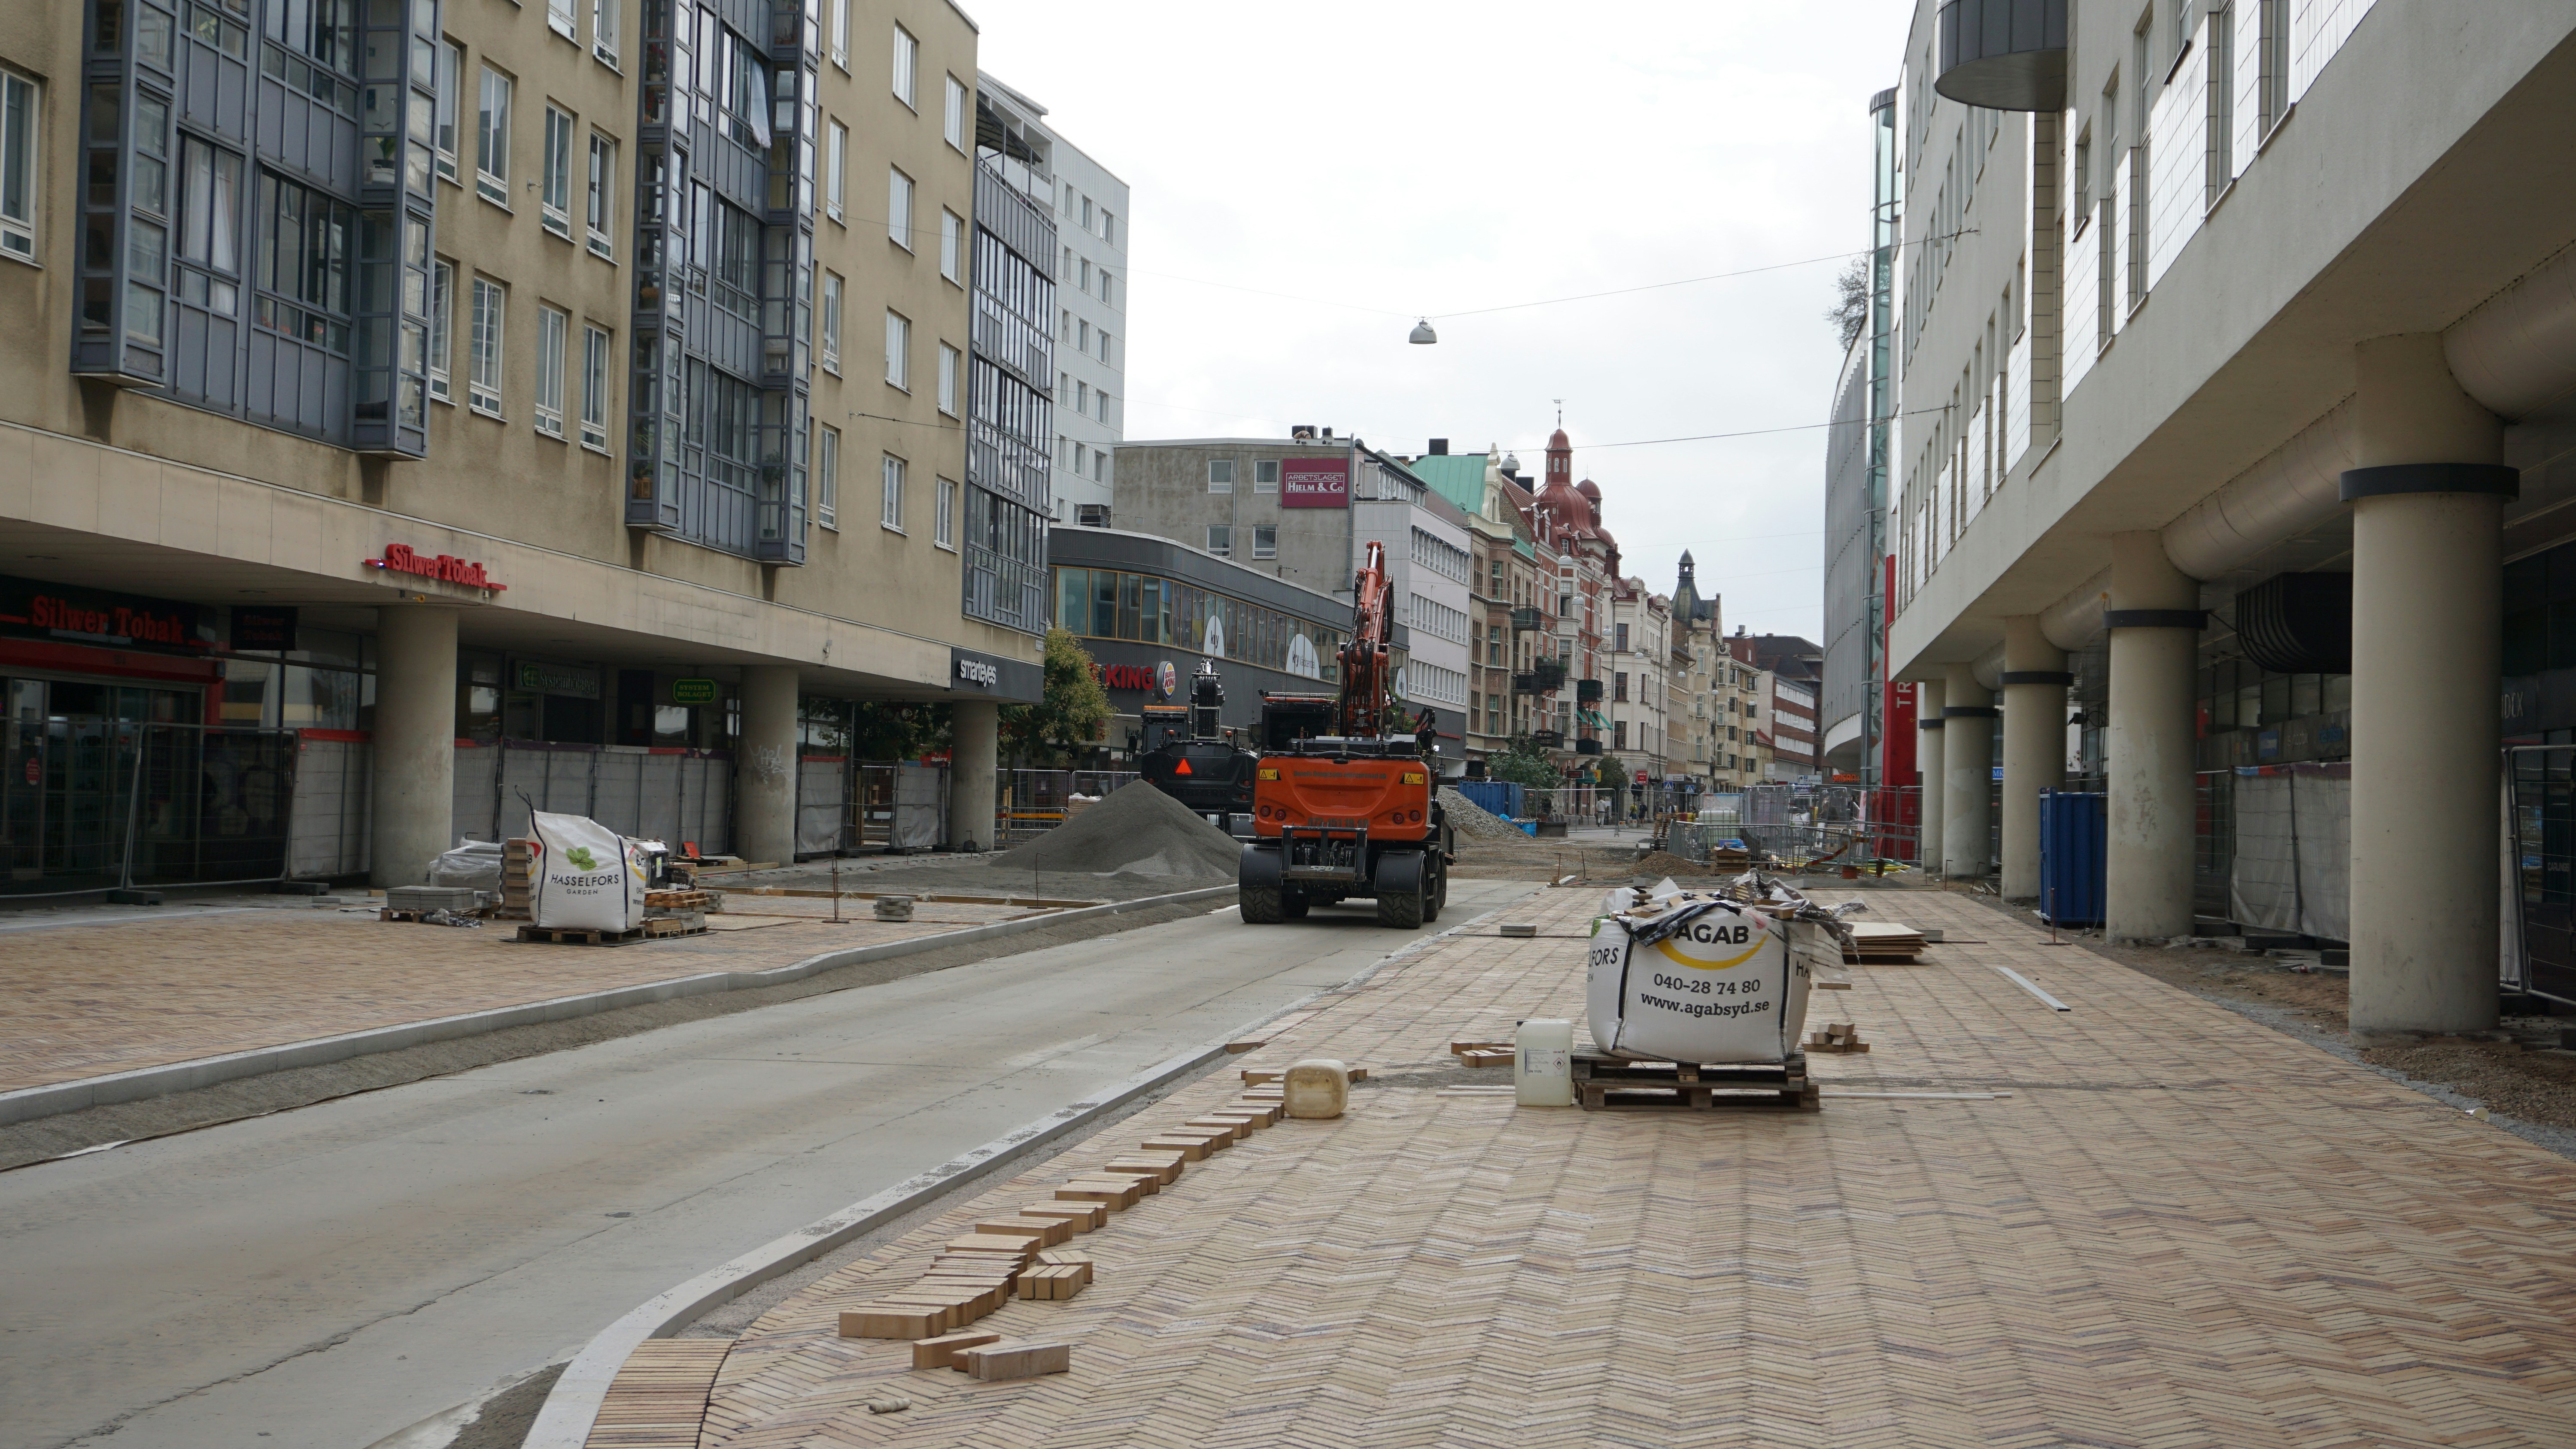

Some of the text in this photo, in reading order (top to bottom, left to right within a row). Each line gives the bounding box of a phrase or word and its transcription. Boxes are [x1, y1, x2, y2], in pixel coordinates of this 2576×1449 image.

[1317, 482, 1328, 491] &
[386, 543, 488, 588] Silwer Tobak
[32, 594, 185, 644] Silwer Tobak
[540, 668, 596, 696] Systembolaget
[960, 659, 996, 688] smarteyes
[1106, 664, 1154, 691] KING
[550, 874, 619, 887] HASSELFORS
[1674, 923, 1750, 944] AGAB
[1654, 973, 1761, 995] 040-28 74 80
[1641, 993, 1770, 1019] www.agabsyd.se
